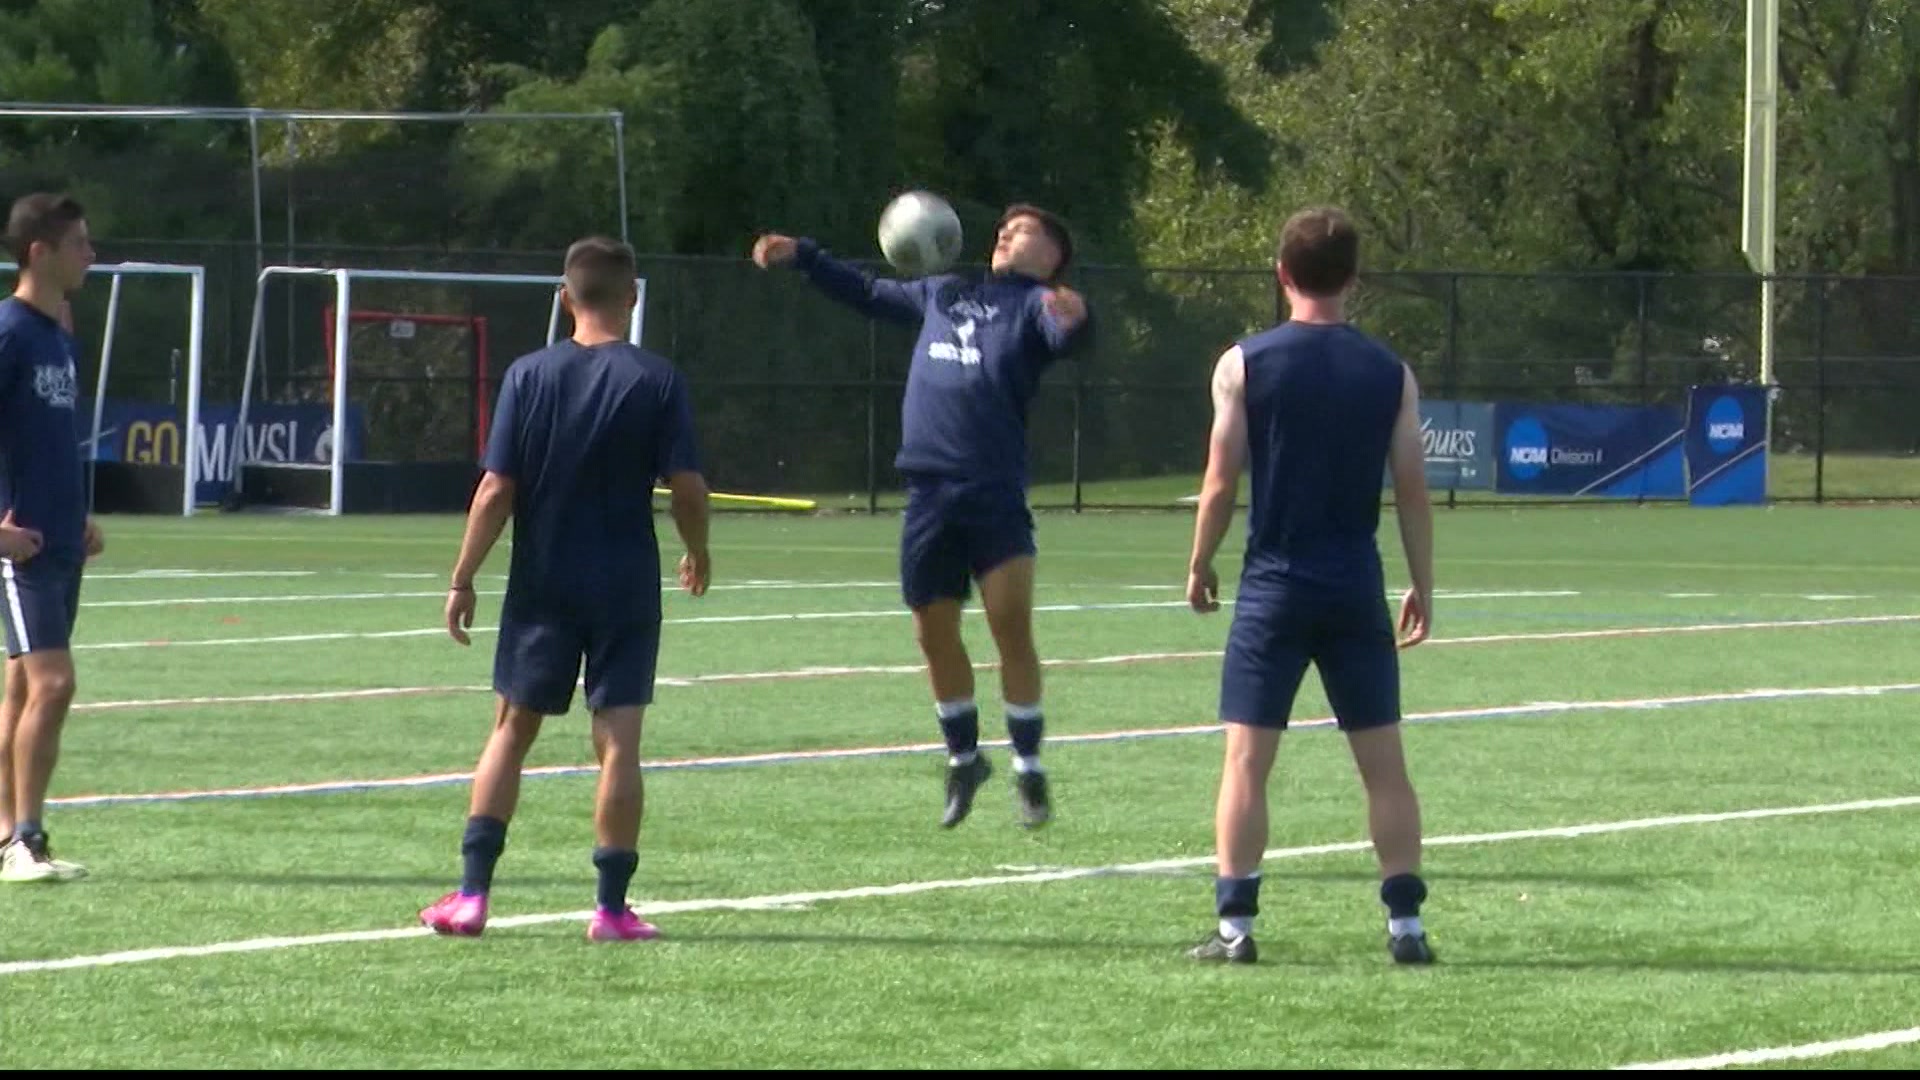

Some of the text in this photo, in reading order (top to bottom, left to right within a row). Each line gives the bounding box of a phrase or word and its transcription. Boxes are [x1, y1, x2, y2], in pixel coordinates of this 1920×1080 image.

[1709, 423, 1744, 438] NCAA
[127, 421, 178, 464] GO
[1509, 447, 1548, 463] NCAA
[1552, 448, 1594, 463] Division
